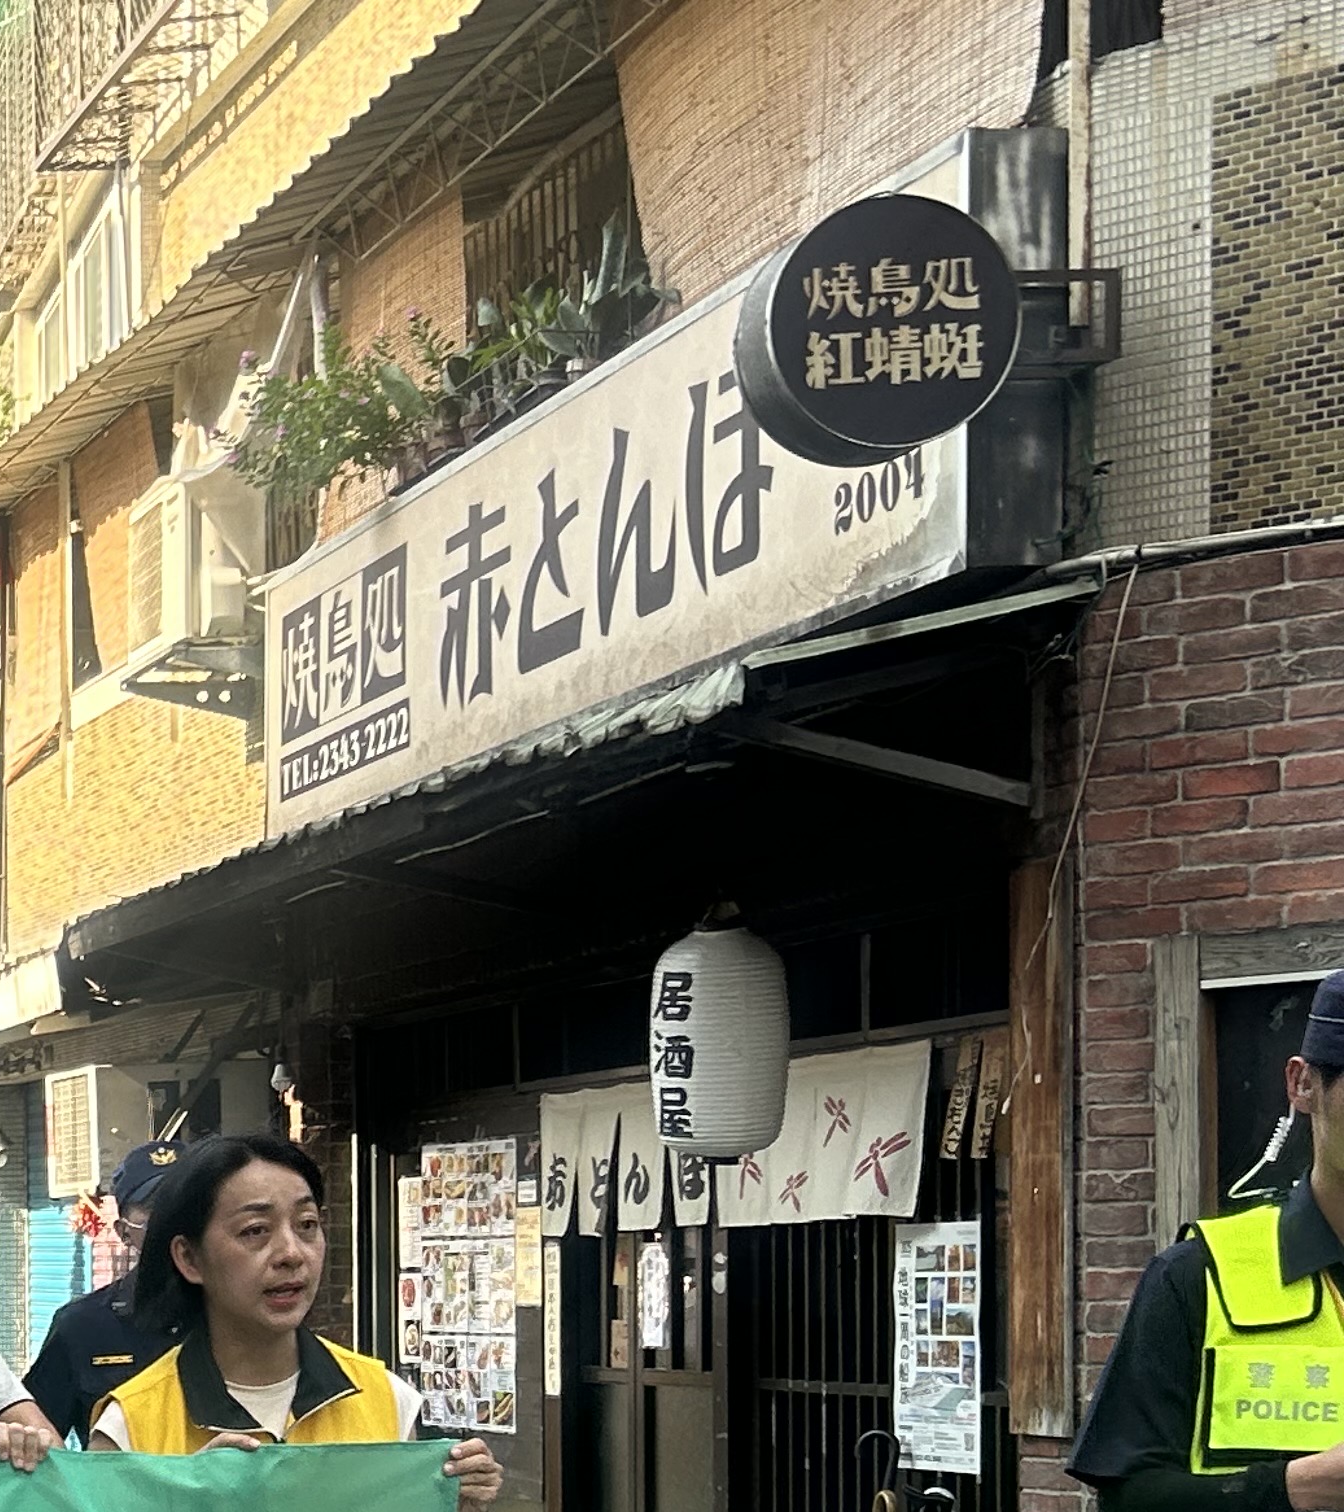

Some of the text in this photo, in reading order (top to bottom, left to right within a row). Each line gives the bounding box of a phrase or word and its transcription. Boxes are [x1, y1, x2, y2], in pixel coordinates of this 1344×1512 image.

[804, 322, 985, 390] 紅蜻蜓
[834, 447, 925, 537] 2004
[653, 971, 696, 1140] 居酒屋
[1247, 1361, 1331, 1390] 警察
[1234, 1398, 1339, 1423] POLICE
